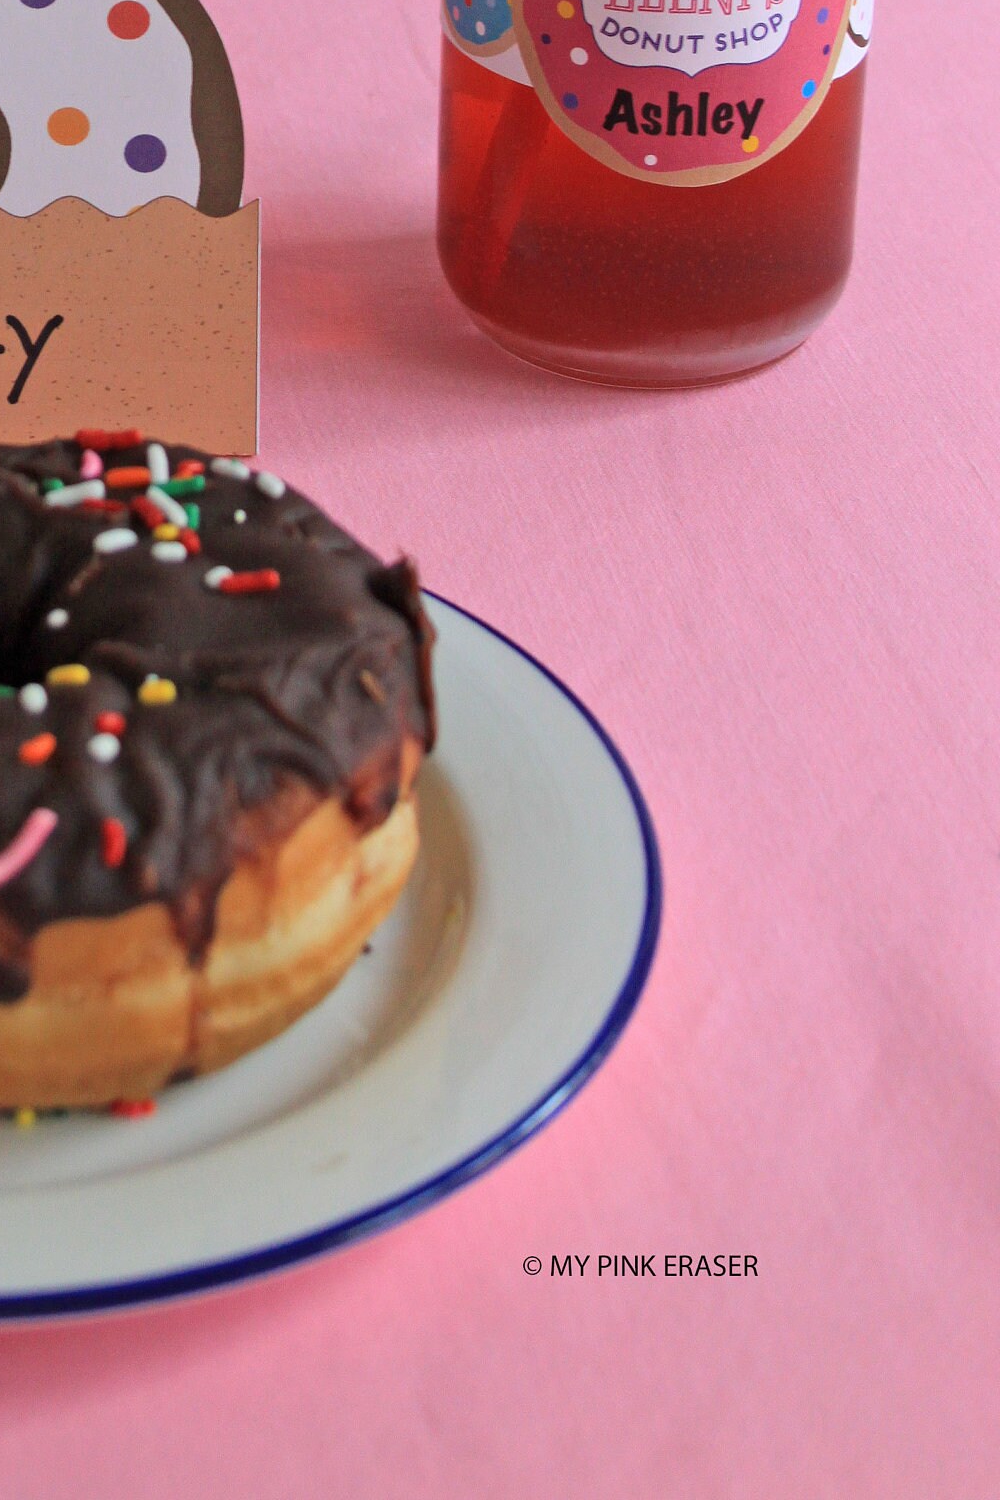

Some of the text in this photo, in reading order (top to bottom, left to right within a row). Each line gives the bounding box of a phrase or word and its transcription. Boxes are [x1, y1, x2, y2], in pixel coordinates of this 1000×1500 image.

[600, 12, 784, 54] DONUT SHOP
[602, 88, 765, 140] Ashley
